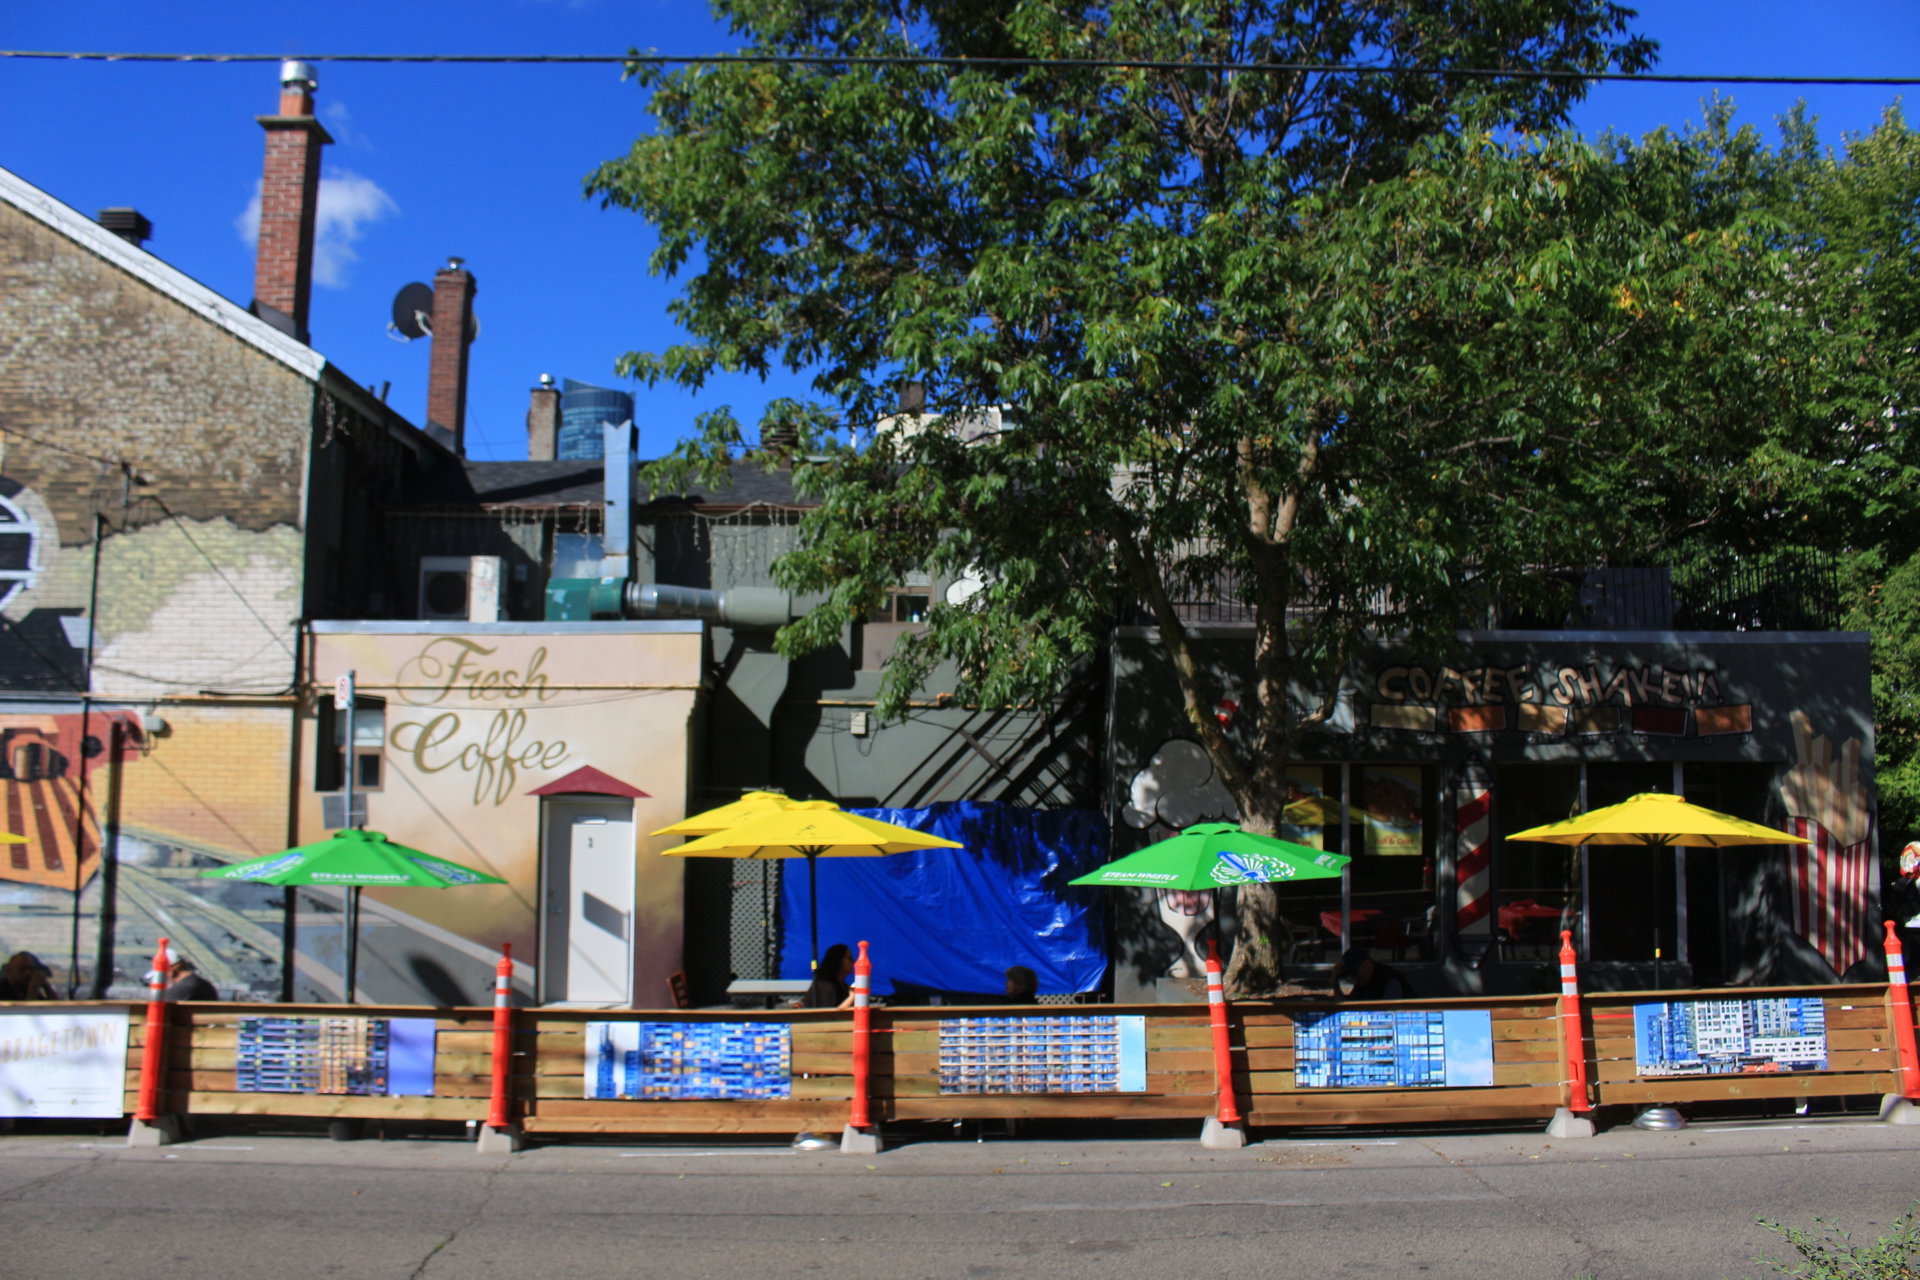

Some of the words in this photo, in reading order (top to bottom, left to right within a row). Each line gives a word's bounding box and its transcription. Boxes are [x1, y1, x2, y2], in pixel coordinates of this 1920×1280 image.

[397, 637, 559, 706] Fresh
[1376, 665, 1537, 704] COFFEE
[390, 708, 571, 806] Coffee
